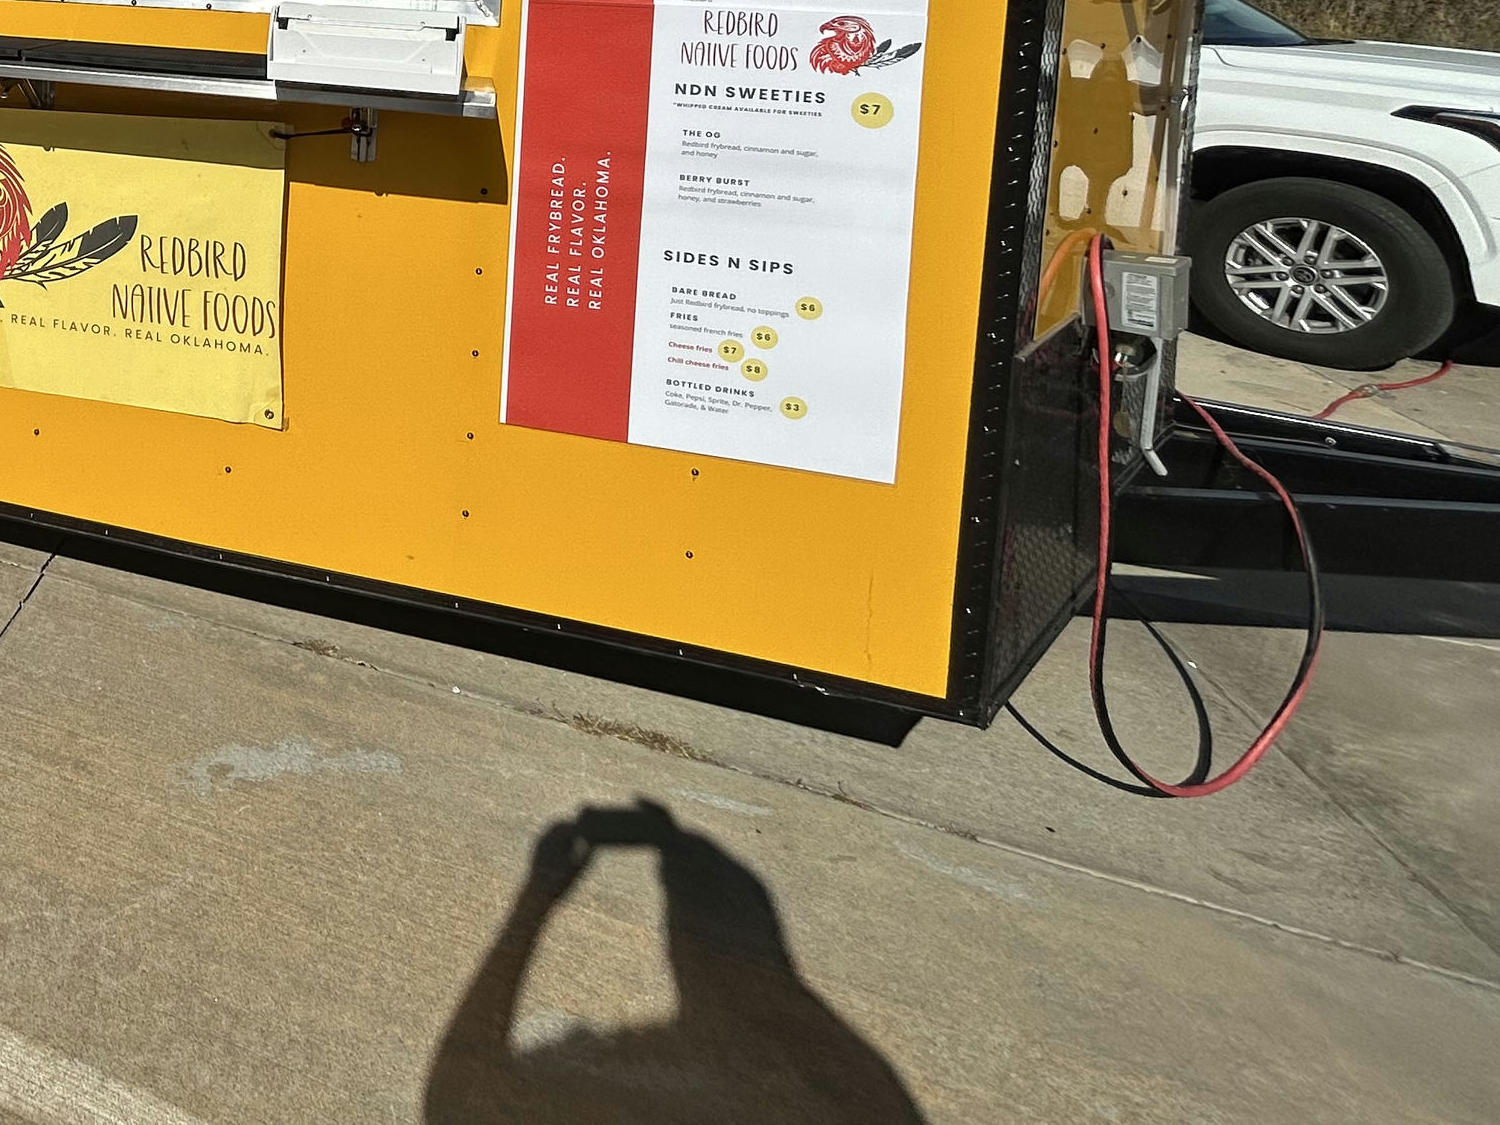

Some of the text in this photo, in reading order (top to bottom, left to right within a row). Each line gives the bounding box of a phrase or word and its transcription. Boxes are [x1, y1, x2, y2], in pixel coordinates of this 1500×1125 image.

[704, 10, 778, 38] REDBIRD
[681, 42, 798, 71] NATIVE FOODS
[675, 83, 825, 104] NDN SWEETIES
[860, 104, 881, 115] $7
[683, 129, 721, 139] THE OG
[680, 174, 750, 187] BERRY BURST
[545, 157, 565, 305] REAL FRYBREAD.
[589, 152, 610, 309] REAL OKLAHOMA.
[567, 183, 586, 307] REAL FLAVOR.
[141, 234, 246, 282] REDBIRD
[664, 250, 793, 275] SIDES N SIPS
[672, 287, 736, 300] BARE BREAD
[113, 284, 276, 339] NATIVE FOODS
[801, 303, 815, 312] $6
[670, 312, 698, 322] FRIES
[11, 314, 45, 328] REAL
[54, 319, 116, 337] FLAVOR.
[125, 328, 162, 342] REAL
[171, 334, 268, 356] OKLAHOMA.
[757, 333, 771, 341] $6
[669, 341, 713, 353] Cheese fries
[724, 346, 737, 354] $7
[746, 365, 760, 374] $8
[666, 379, 754, 398] BOTTLED DRINKS
[786, 403, 800, 412] $3
